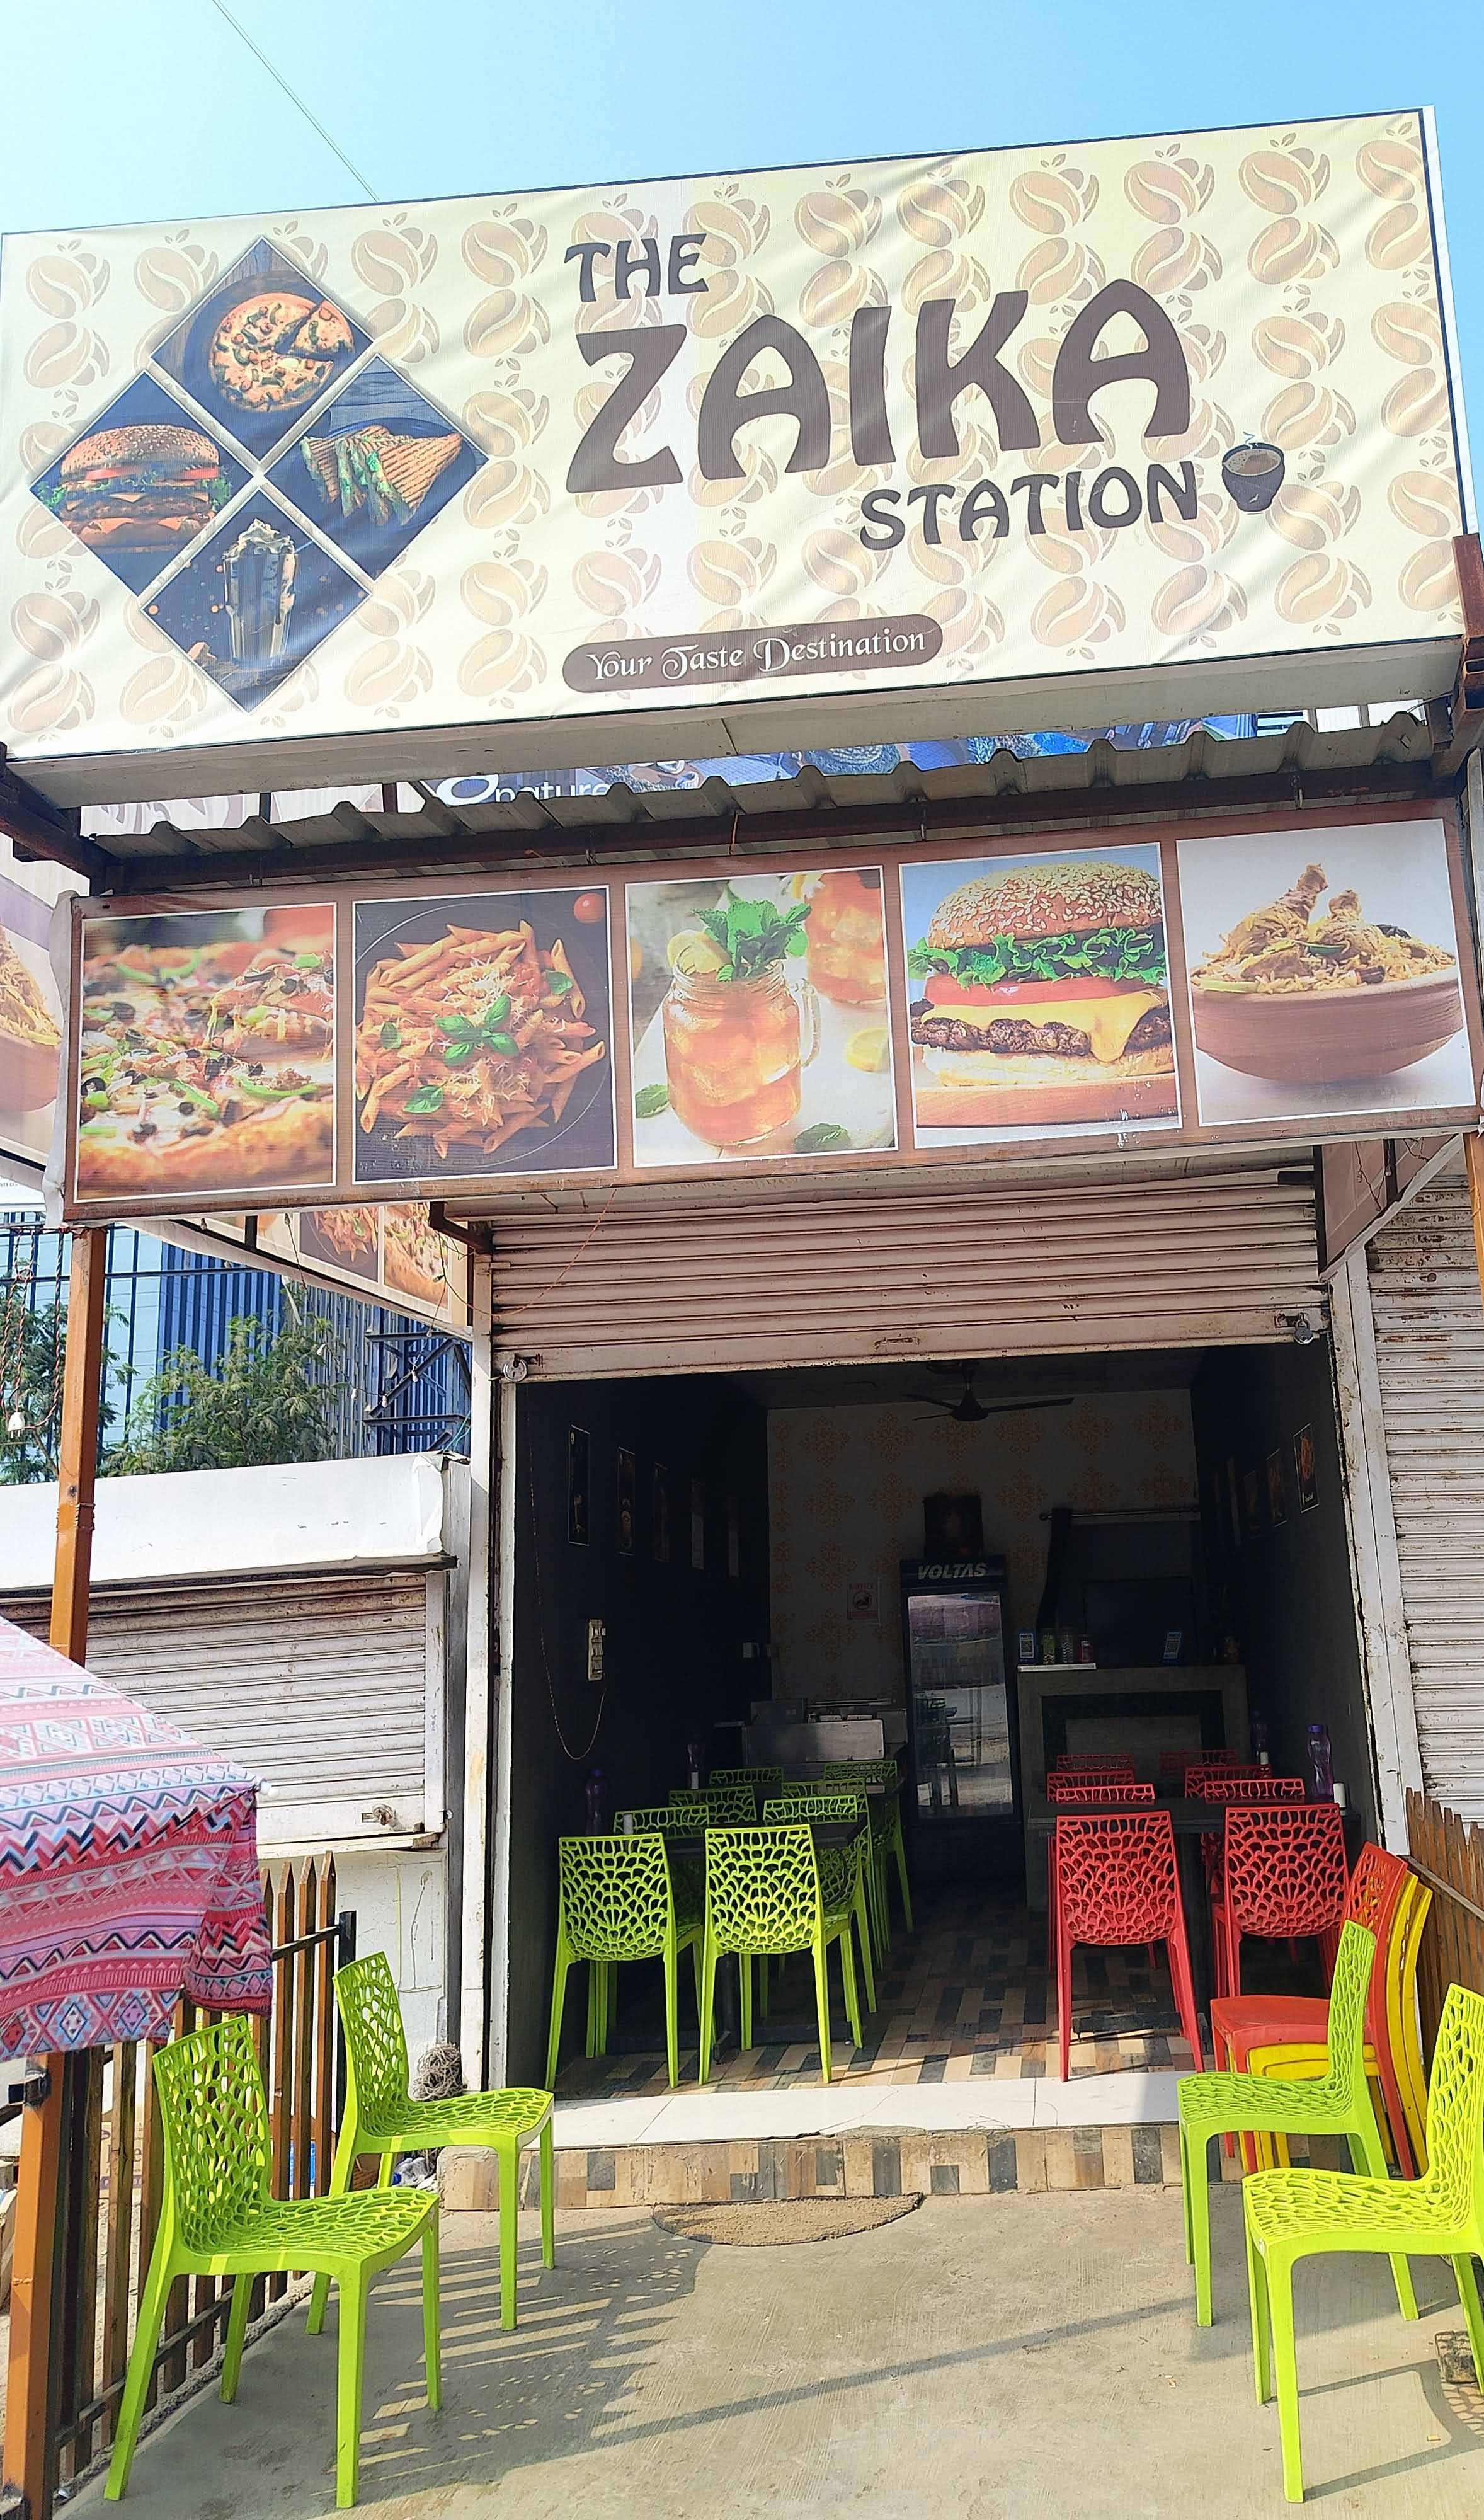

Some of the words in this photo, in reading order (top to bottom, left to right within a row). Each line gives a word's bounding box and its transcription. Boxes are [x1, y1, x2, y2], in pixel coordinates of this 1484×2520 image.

[564, 233, 709, 303] THE
[566, 278, 1190, 494] ZAIKA
[860, 461, 1197, 551] STATION
[586, 651, 652, 680] Your
[661, 644, 743, 680] Taste
[753, 628, 926, 673] Destination
[917, 1562, 988, 1579] VOLTAS
